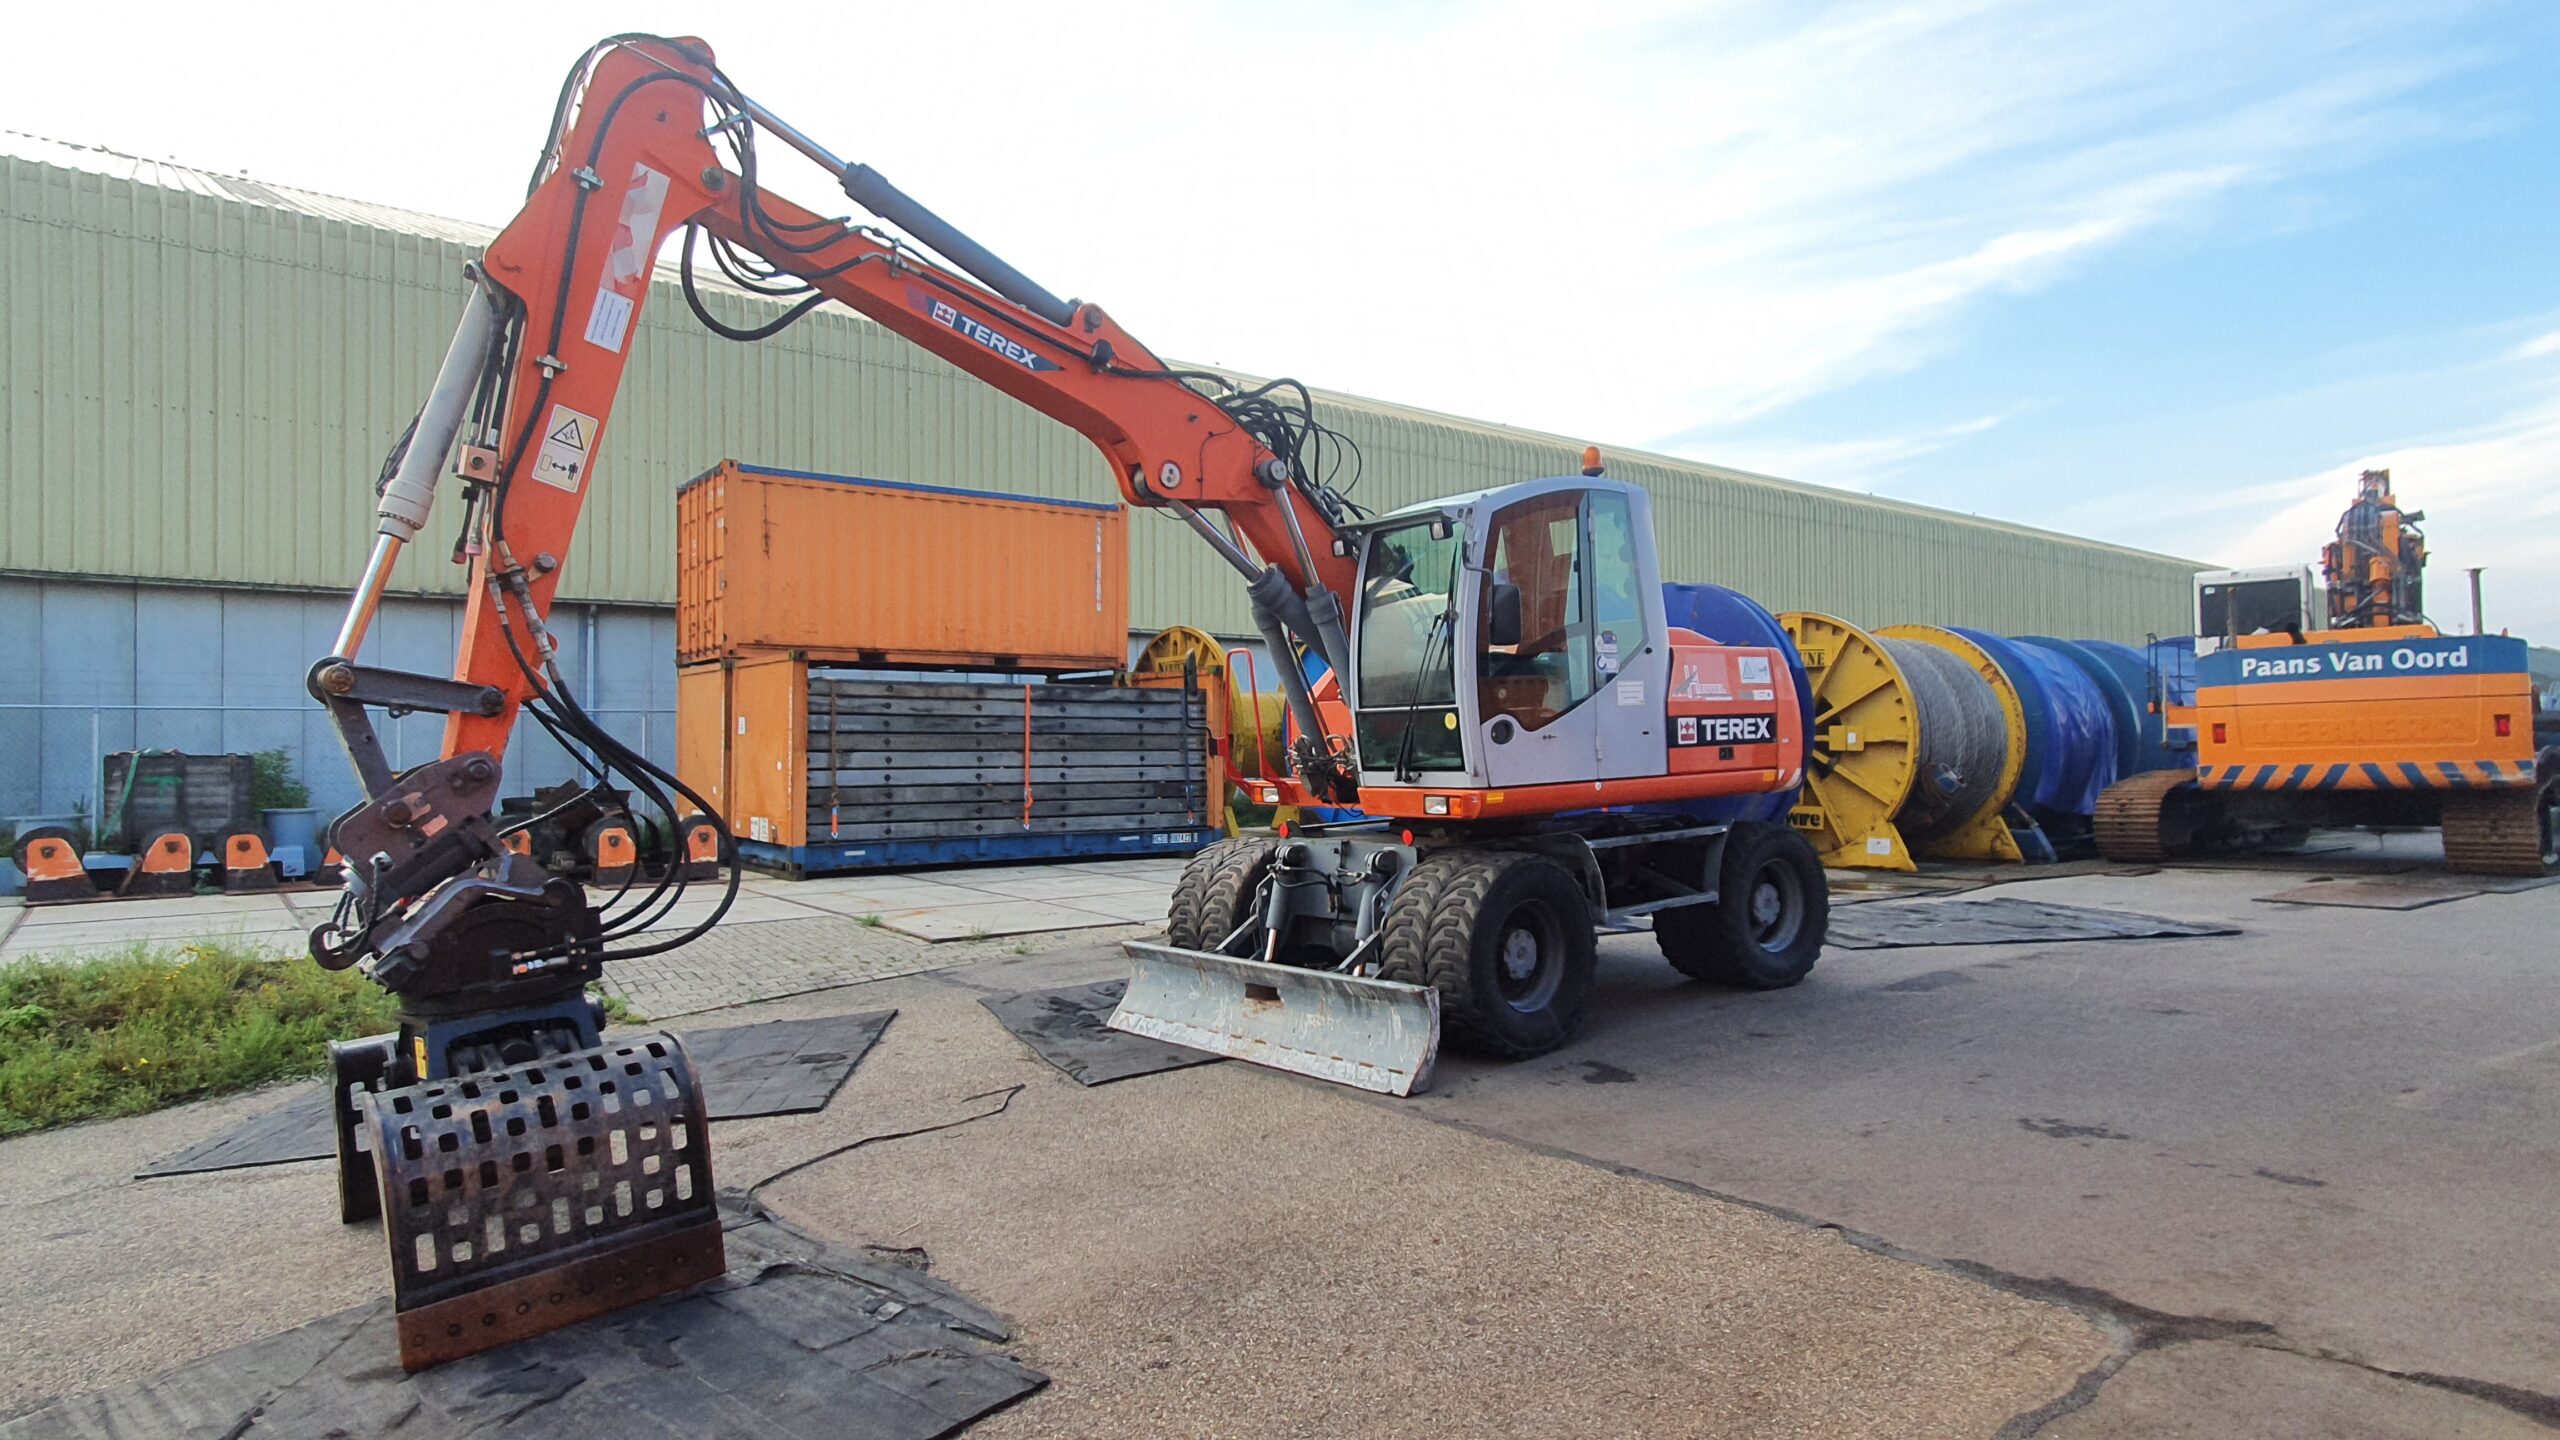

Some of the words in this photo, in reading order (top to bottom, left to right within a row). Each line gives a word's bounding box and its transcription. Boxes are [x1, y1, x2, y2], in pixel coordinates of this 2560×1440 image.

[961, 315, 1038, 370] TEREX
[2241, 656, 2322, 678] Paans
[2328, 651, 2383, 672] Van
[2391, 645, 2468, 669] Oord
[1701, 717, 1771, 741] TEREX
